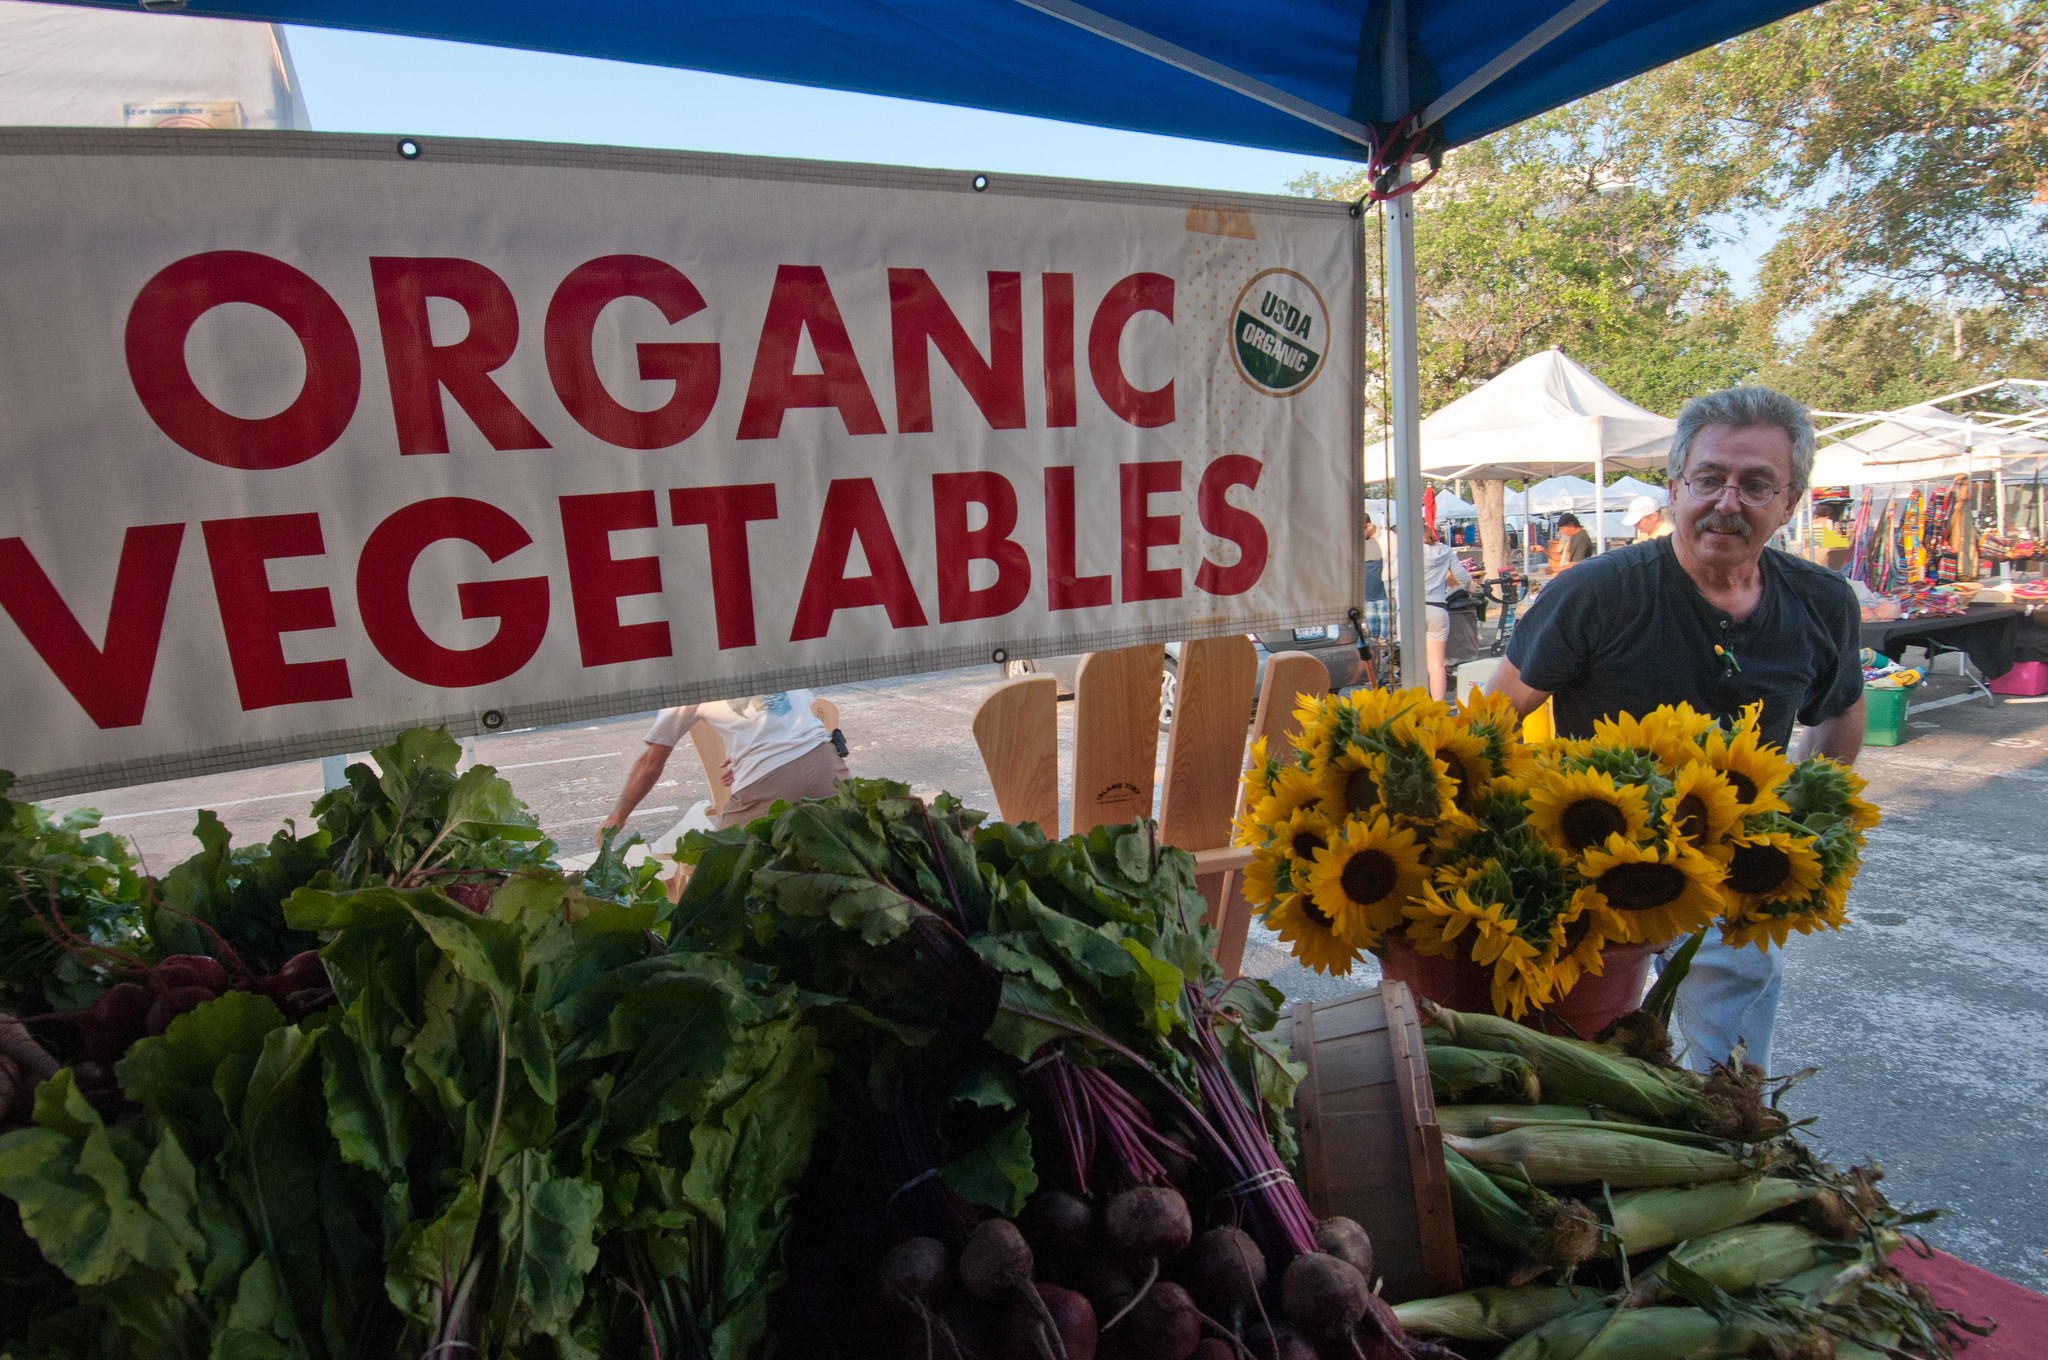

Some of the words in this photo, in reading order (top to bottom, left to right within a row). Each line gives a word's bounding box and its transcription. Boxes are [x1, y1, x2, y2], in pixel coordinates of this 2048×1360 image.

[126, 250, 1175, 471] ORGANIC
[1242, 322, 1309, 373] ORGANIC
[1260, 290, 1312, 341] USDA
[0, 454, 1269, 729] VEGETABLES
